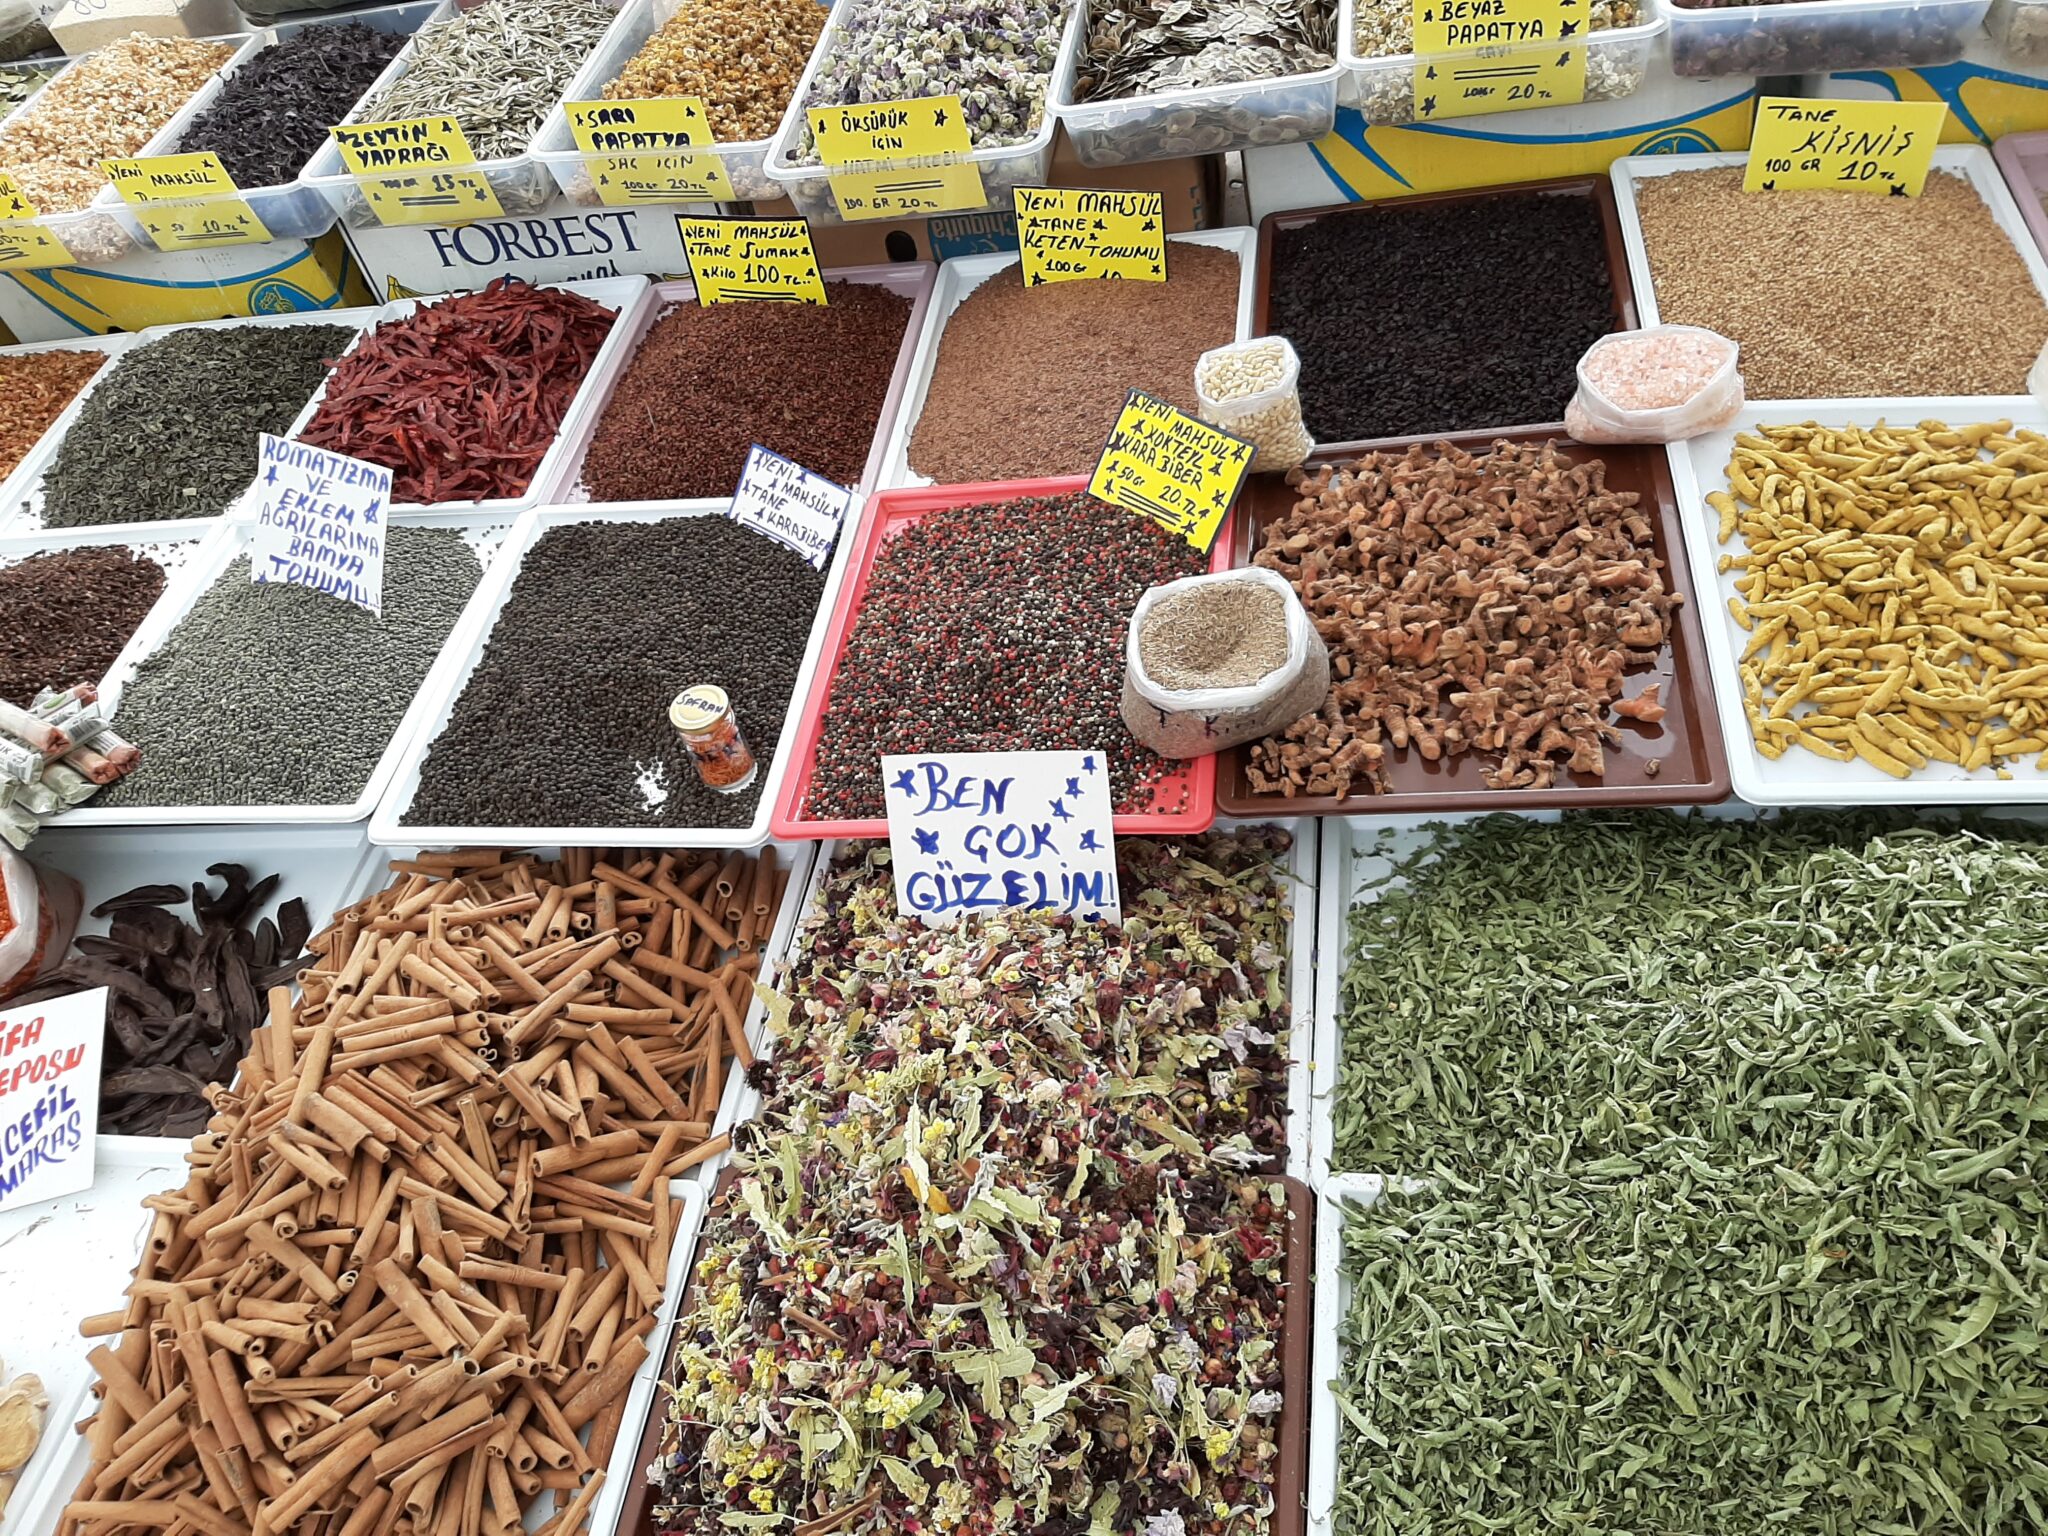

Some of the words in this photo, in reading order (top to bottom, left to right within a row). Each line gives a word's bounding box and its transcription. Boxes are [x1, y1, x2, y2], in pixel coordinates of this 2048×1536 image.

[1439, 0, 1506, 21] BEYAZ
[1447, 19, 1543, 46] PAPATYA
[1507, 83, 1535, 100] 20
[841, 108, 908, 133] ÖKSÜRÜK
[1767, 105, 1838, 123] TANE
[591, 132, 690, 150] PAPATYA
[150, 169, 217, 188] MAHSÜL
[1765, 158, 1792, 173] 100
[1837, 160, 1878, 181] 10
[431, 174, 456, 193] 15
[667, 178, 688, 190] 20
[900, 198, 920, 209] 20
[1077, 193, 1162, 217] MAHSÜL
[203, 220, 220, 234] 10
[733, 223, 799, 239] MAHSÜL
[1040, 219, 1087, 231] TANE
[424, 210, 642, 268] FORBEST
[692, 242, 731, 257] TANE
[1024, 229, 1086, 250] KETEN
[1084, 245, 1160, 261] TOHUMU
[744, 263, 780, 284] 100
[1045, 259, 1070, 272] 100
[1169, 420, 1230, 460] MAHSÜL
[263, 436, 389, 493] ROMATİZMA
[306, 473, 334, 496] VE
[278, 488, 355, 526] EKLEM
[751, 484, 788, 511] TANE
[781, 480, 830, 516] MAHSÜL
[286, 535, 364, 577] BAMYA
[913, 761, 1016, 817] BEN
